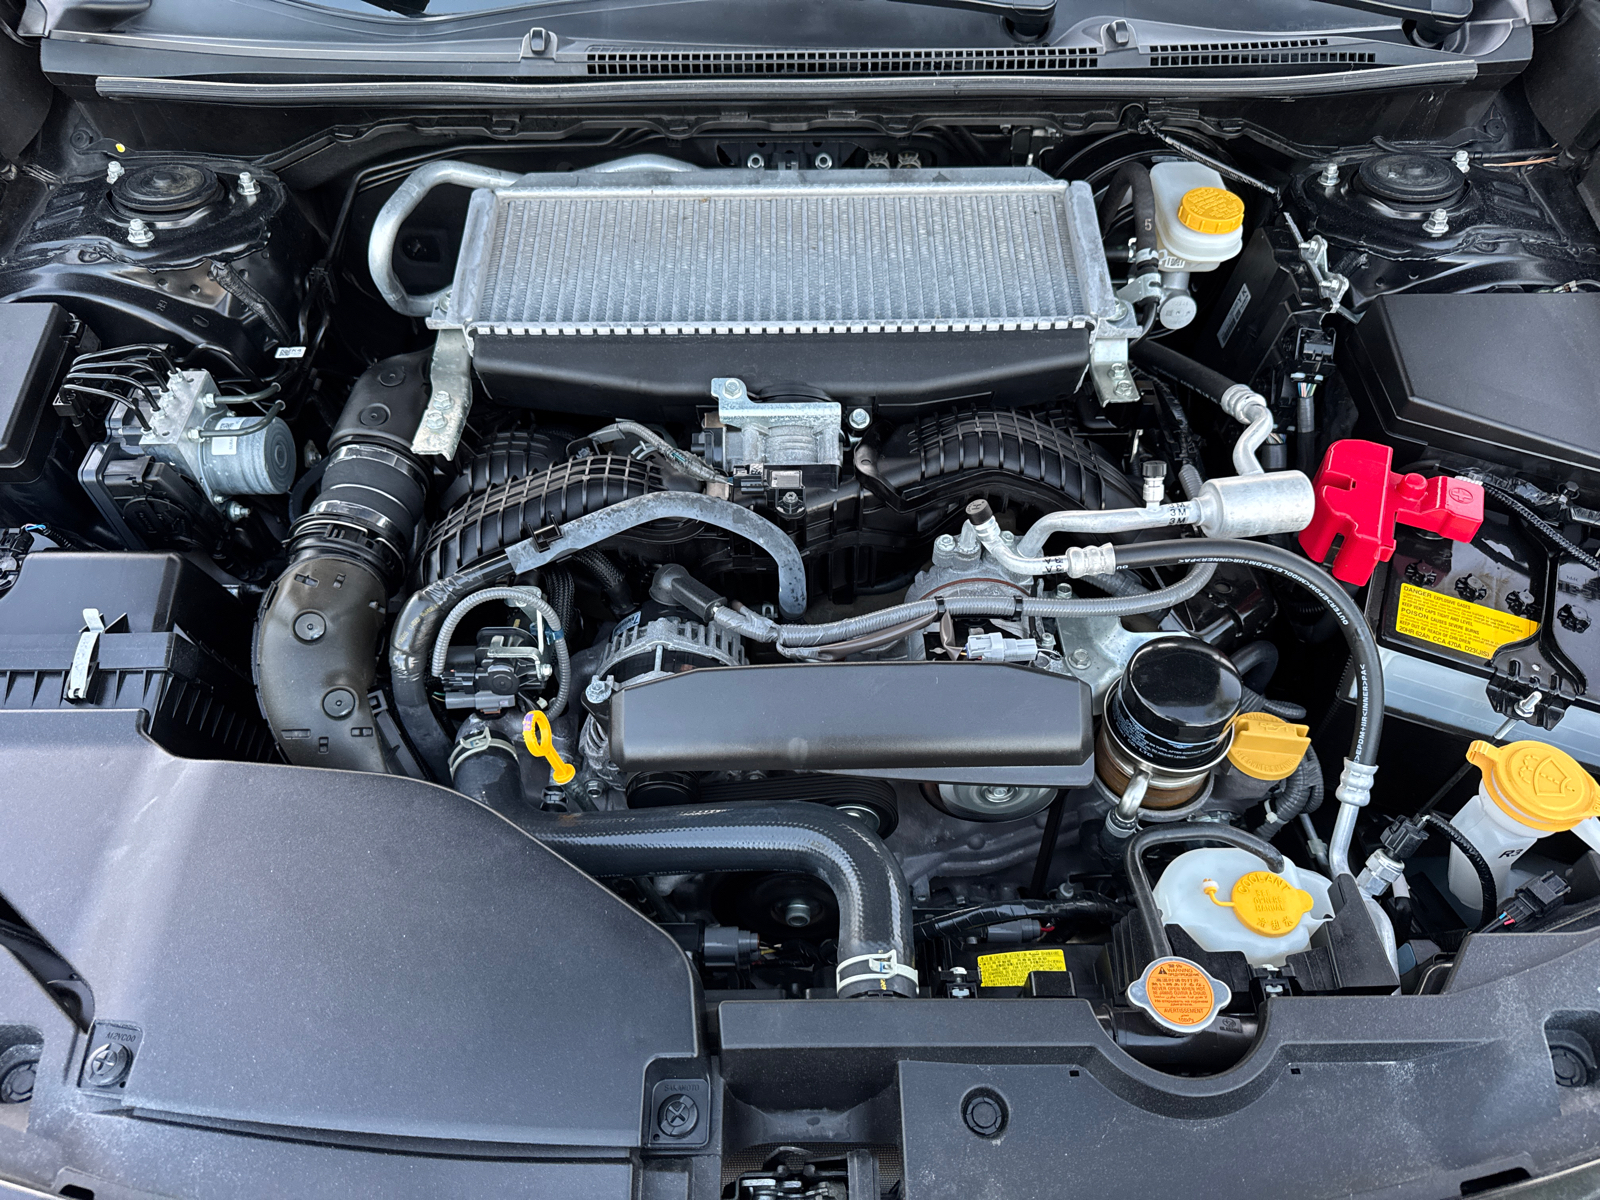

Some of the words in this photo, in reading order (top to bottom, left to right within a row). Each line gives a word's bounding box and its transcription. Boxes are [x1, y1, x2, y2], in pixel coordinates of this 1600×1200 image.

[1403, 585, 1431, 598] DANGER
[1401, 607, 1428, 619] POISON
[1498, 848, 1523, 859] R3
[1237, 873, 1291, 894] COOLANT
